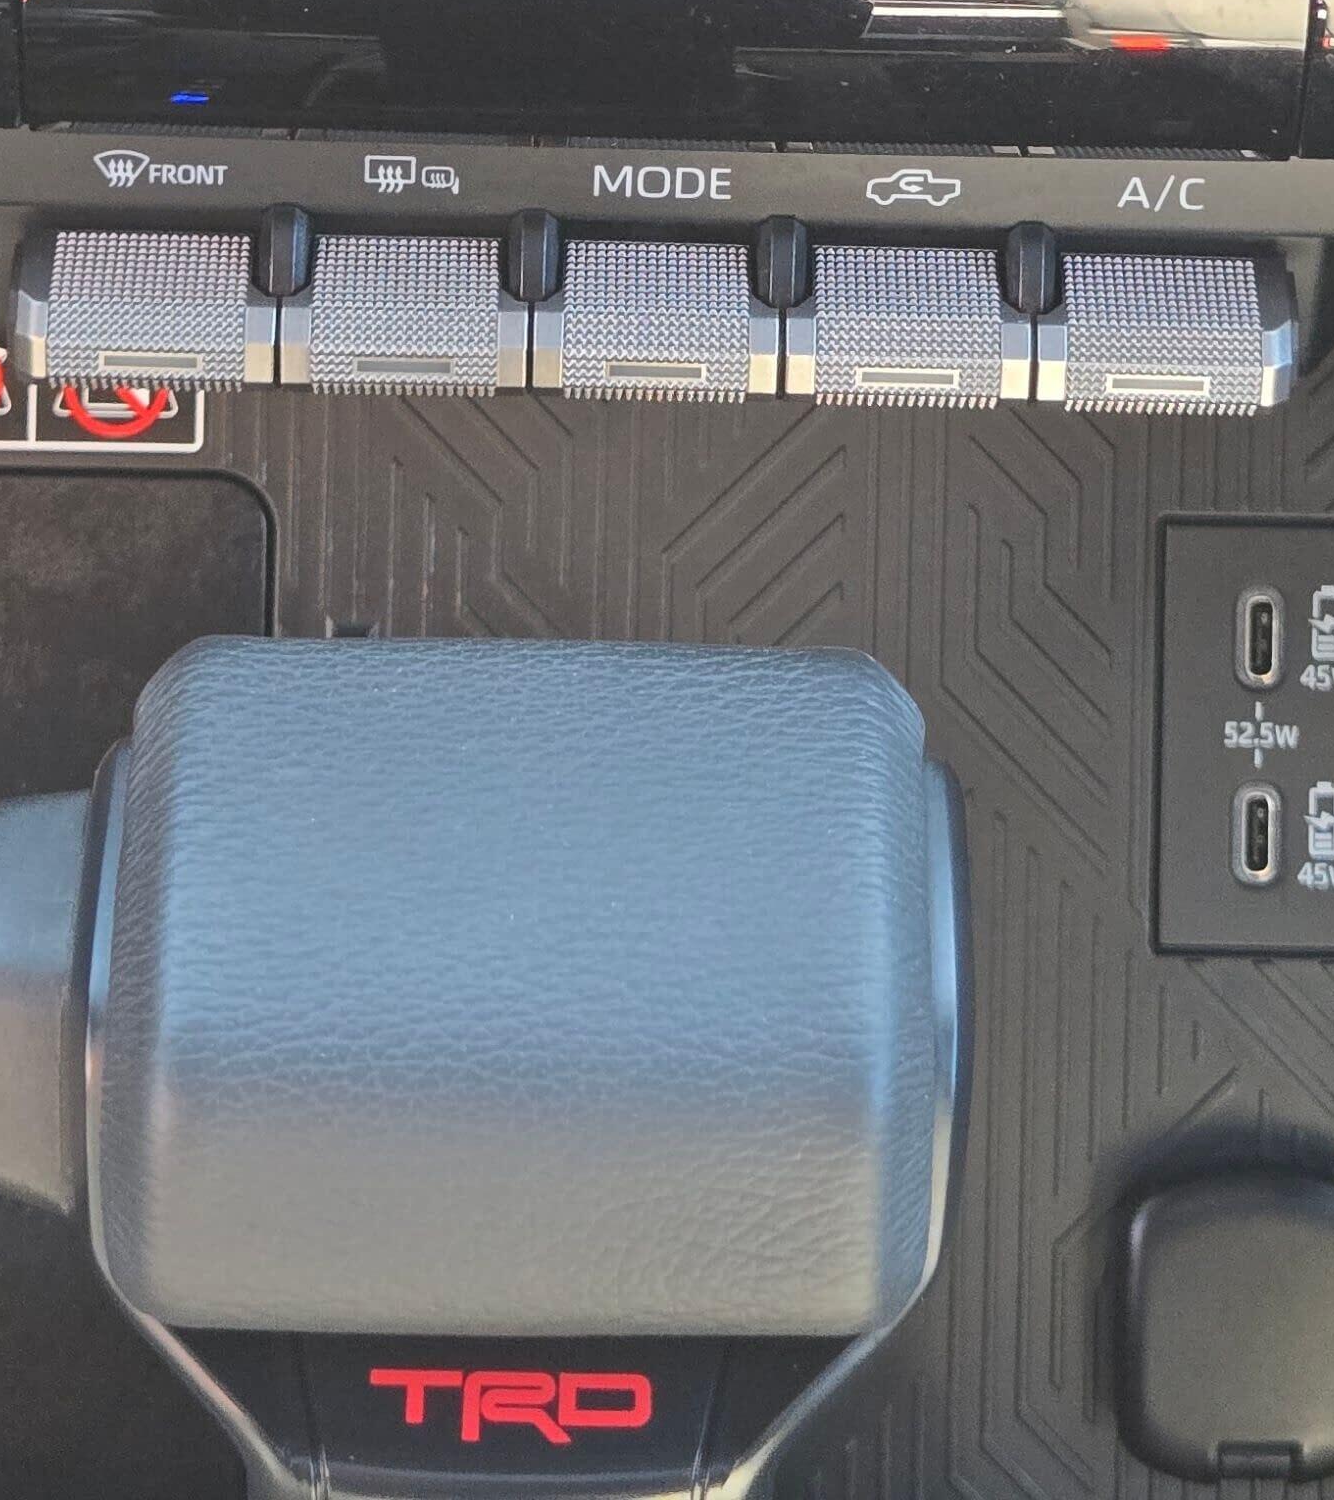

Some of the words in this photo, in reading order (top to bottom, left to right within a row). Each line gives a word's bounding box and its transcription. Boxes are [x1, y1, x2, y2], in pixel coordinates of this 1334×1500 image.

[148, 163, 229, 186] FRONT
[593, 164, 732, 200] MODE
[1117, 174, 1205, 212] A/C
[1223, 721, 1300, 749] 52.5W
[369, 1367, 653, 1446] TRD
